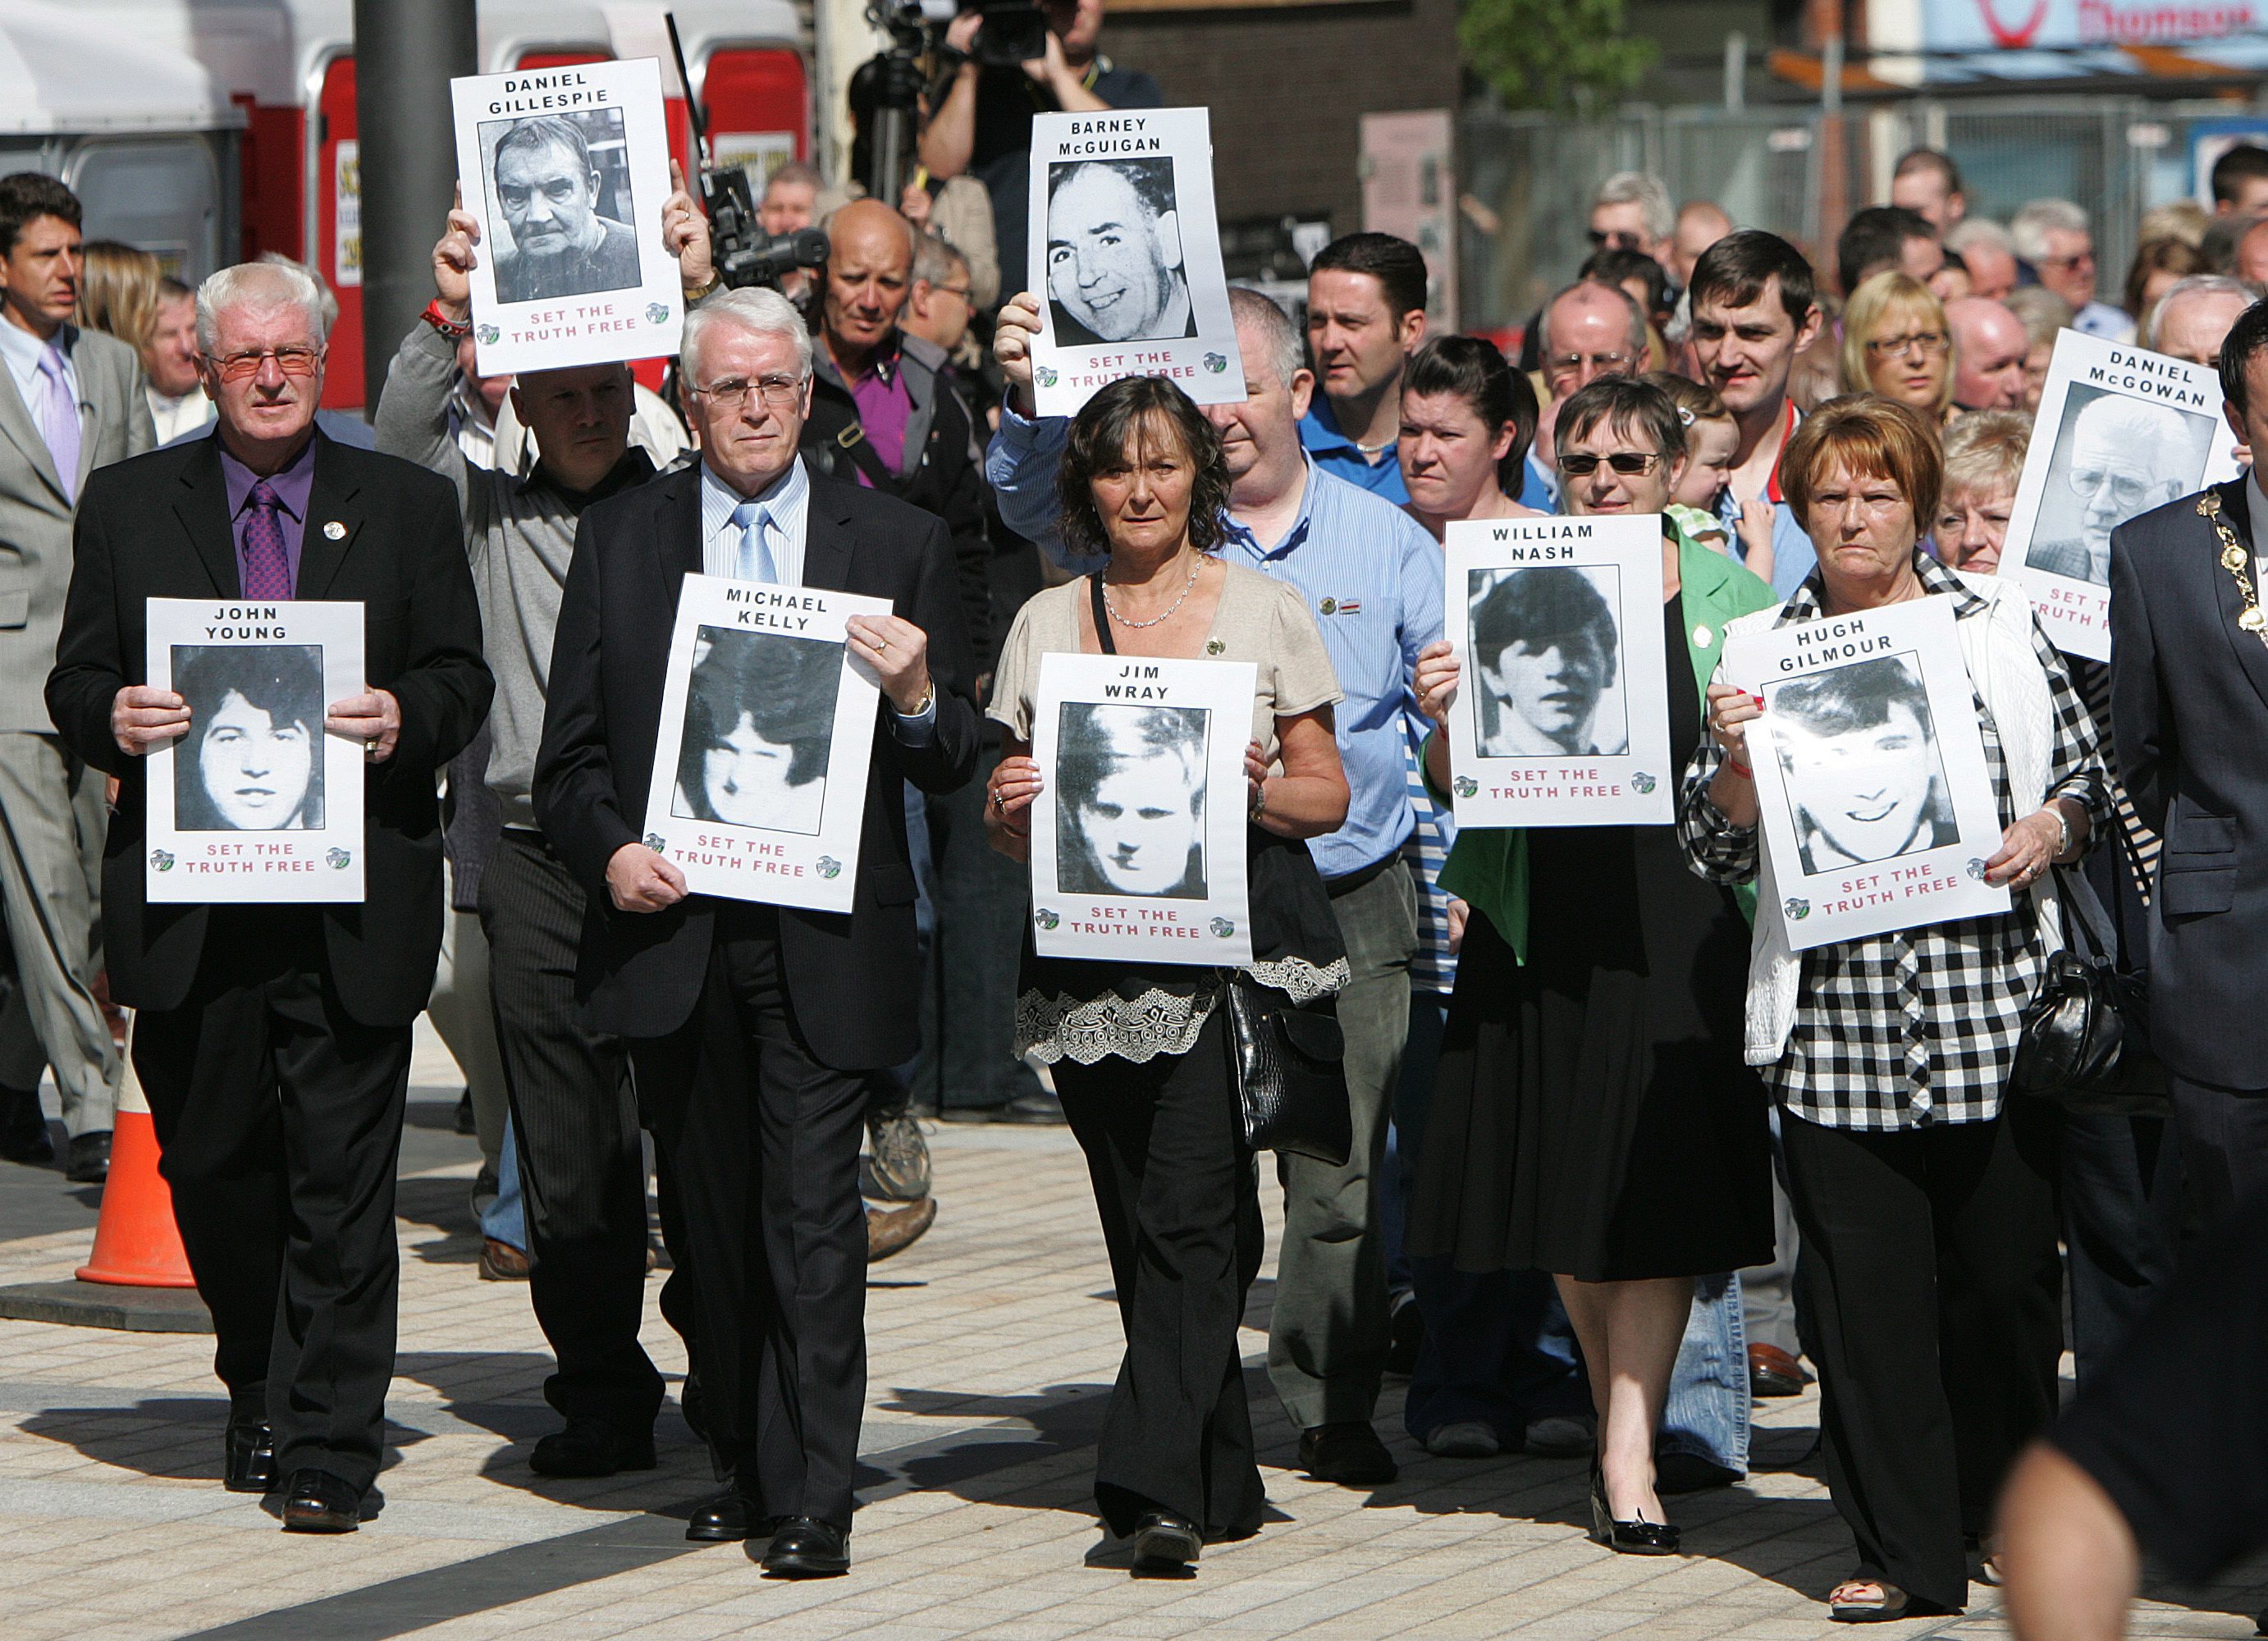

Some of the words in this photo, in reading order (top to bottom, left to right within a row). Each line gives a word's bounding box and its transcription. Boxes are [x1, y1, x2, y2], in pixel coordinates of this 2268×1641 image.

[505, 74, 586, 93] DANIEL
[490, 89, 607, 114] GILLESPIE
[1072, 119, 1145, 135] BARNEY
[1059, 138, 1159, 155] McGUIGAN
[531, 311, 565, 324] SET
[577, 304, 613, 318] THE
[512, 327, 576, 343] TRUTH
[588, 318, 635, 334] FREE
[1090, 355, 1124, 368] SET
[1135, 352, 1172, 363] THE
[2110, 351, 2193, 383] DANIEL
[1146, 367, 1194, 378] FREE
[2089, 367, 2204, 407] McGOWAN
[1493, 525, 1591, 540] WILLIAM
[1513, 546, 1572, 560] NASH
[727, 589, 826, 612] MICHAEL
[2051, 588, 2087, 606] SET
[214, 608, 276, 619] JOHN
[738, 610, 808, 630] KELLY
[206, 627, 285, 639] YOUNG
[1797, 619, 1865, 646] HUGH
[1781, 635, 1892, 671] GILMOUR
[1120, 666, 1158, 679] JIM
[1105, 685, 1168, 699] WRAY
[1511, 770, 1547, 781] SET
[1559, 770, 1598, 779] THE
[1490, 788, 1557, 798] TRUTH
[1571, 785, 1621, 797] FREE
[208, 844, 243, 856] SET
[255, 844, 293, 855] THE
[698, 835, 734, 849] SET
[746, 842, 784, 857] THE
[186, 862, 253, 872] TRUTH
[265, 861, 314, 871] FREE
[676, 850, 741, 870] TRUTH
[753, 861, 803, 877] FREE
[1842, 875, 1879, 893] SET
[1891, 864, 1932, 881] THE
[1823, 891, 1893, 914] TRUTH
[1905, 876, 1957, 897] FREE
[1091, 907, 1127, 918] SET
[1138, 910, 1177, 921] THE
[1071, 922, 1137, 935] TRUTH
[1150, 926, 1199, 938] FREE
